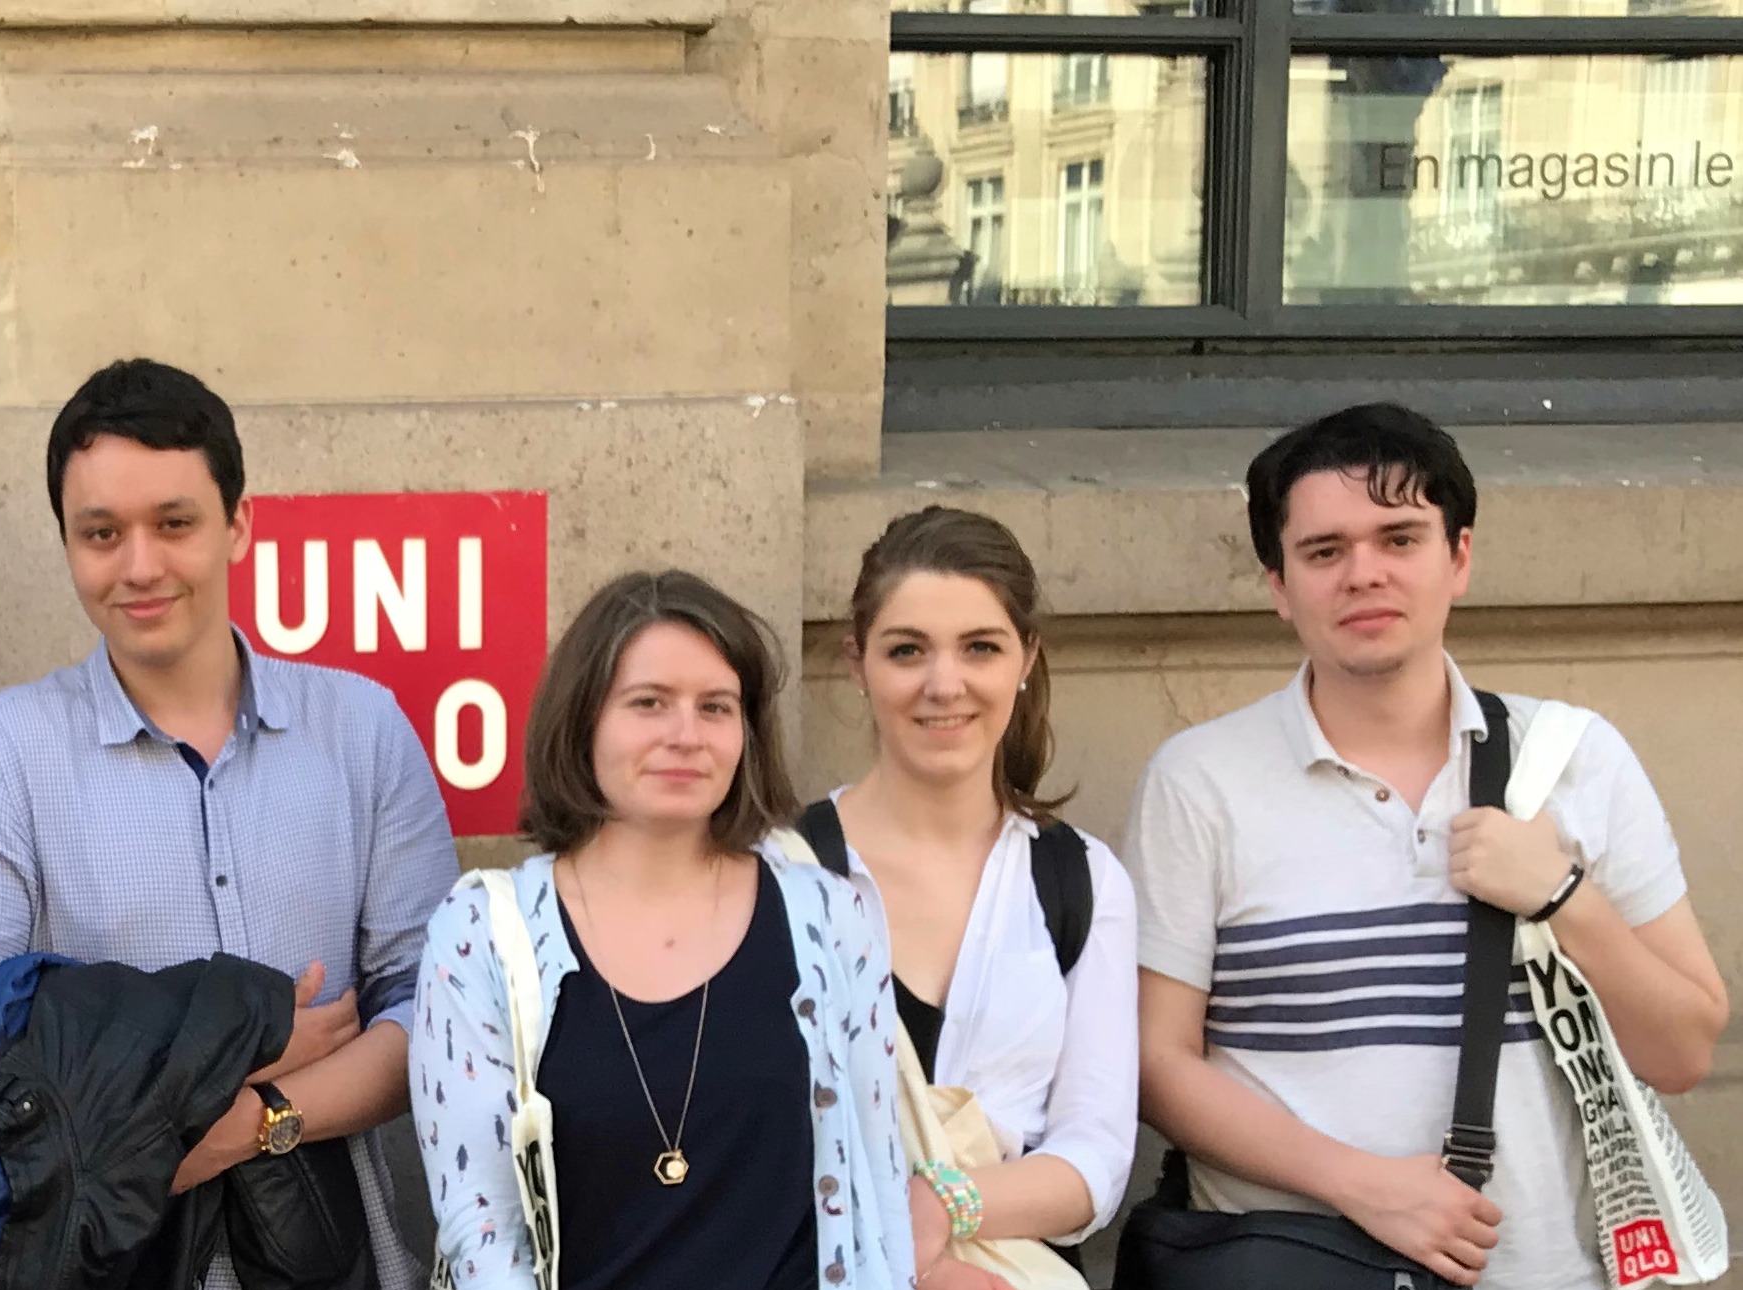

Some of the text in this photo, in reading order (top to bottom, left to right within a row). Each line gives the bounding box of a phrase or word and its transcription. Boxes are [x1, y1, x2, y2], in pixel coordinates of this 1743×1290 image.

[1379, 140, 1733, 200] En magasin le
[255, 536, 482, 654] UNI
[1619, 1225, 1661, 1253] UNI
[1623, 1249, 1670, 1278] QLO
